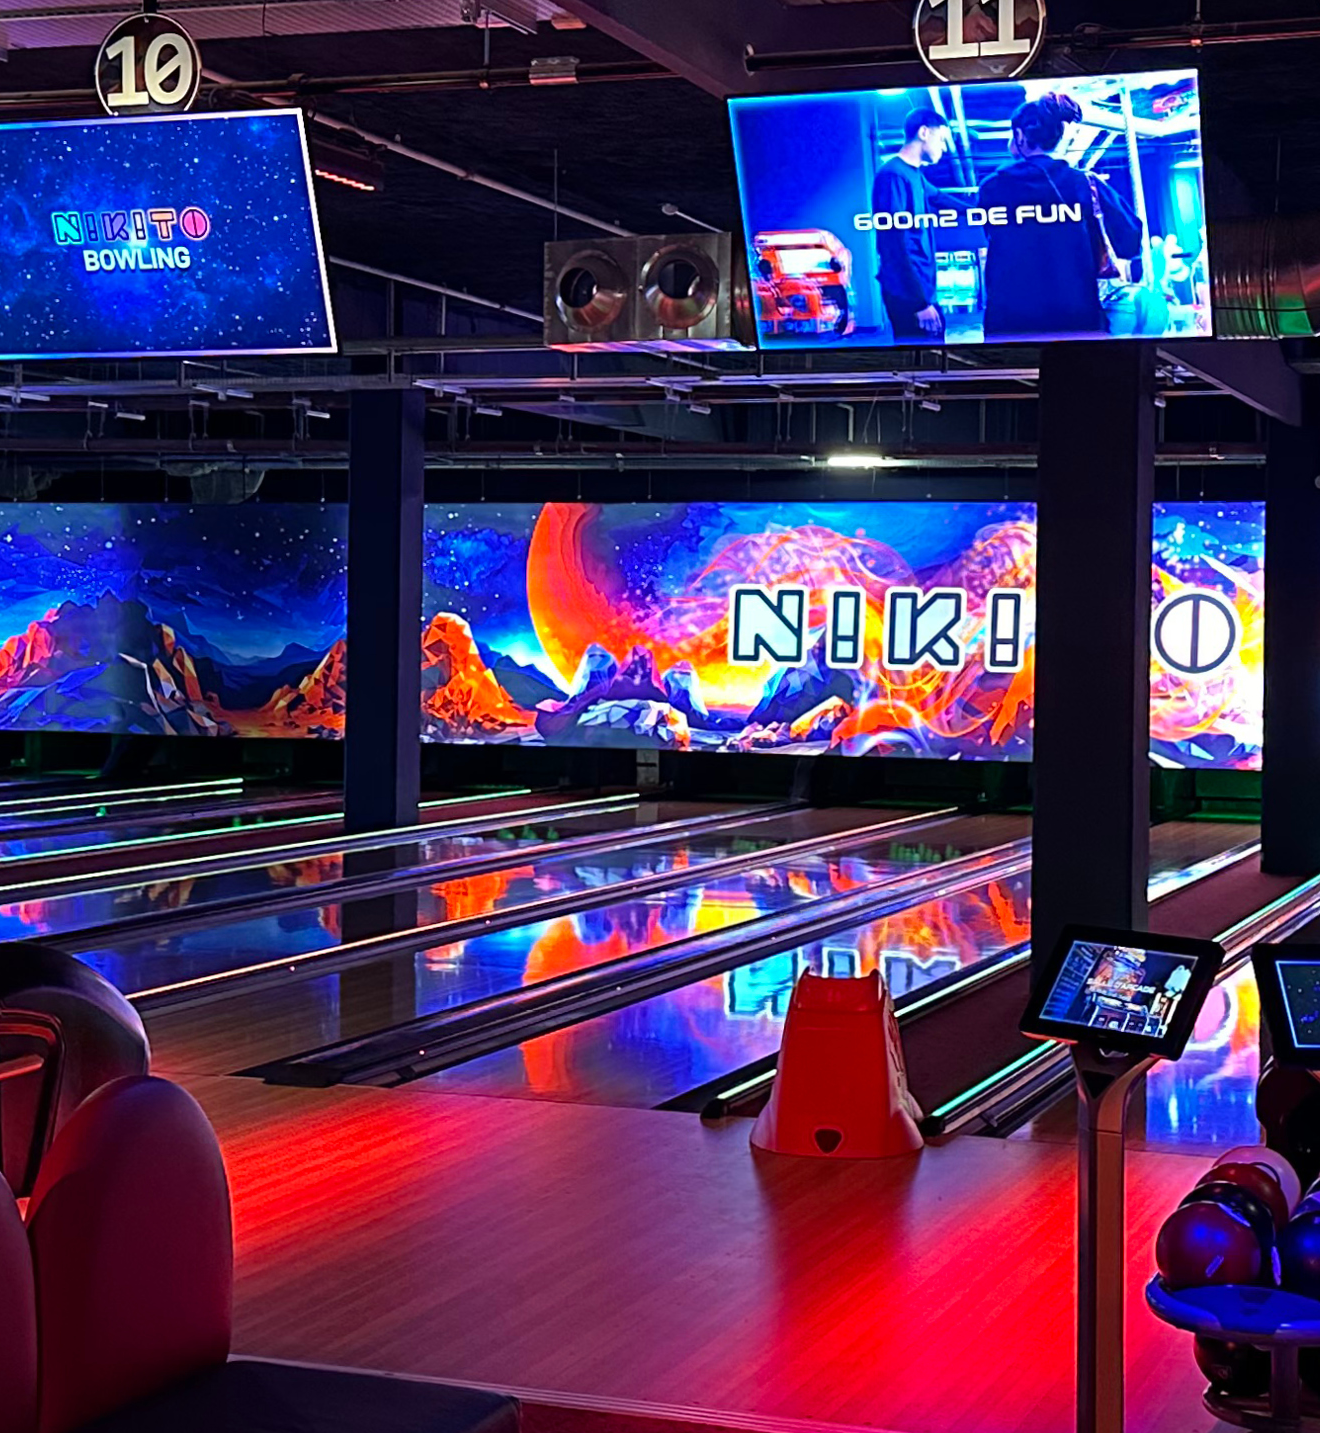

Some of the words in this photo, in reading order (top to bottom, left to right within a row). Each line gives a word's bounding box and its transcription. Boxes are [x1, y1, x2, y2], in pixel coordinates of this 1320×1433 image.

[928, 0, 1030, 60] 11
[105, 32, 193, 107] 10
[853, 208, 958, 231] 600m2
[966, 206, 1008, 226] DE
[1016, 202, 1082, 225] FUN
[83, 246, 191, 272] BOWLING
[729, 586, 1239, 675] NIKIO
